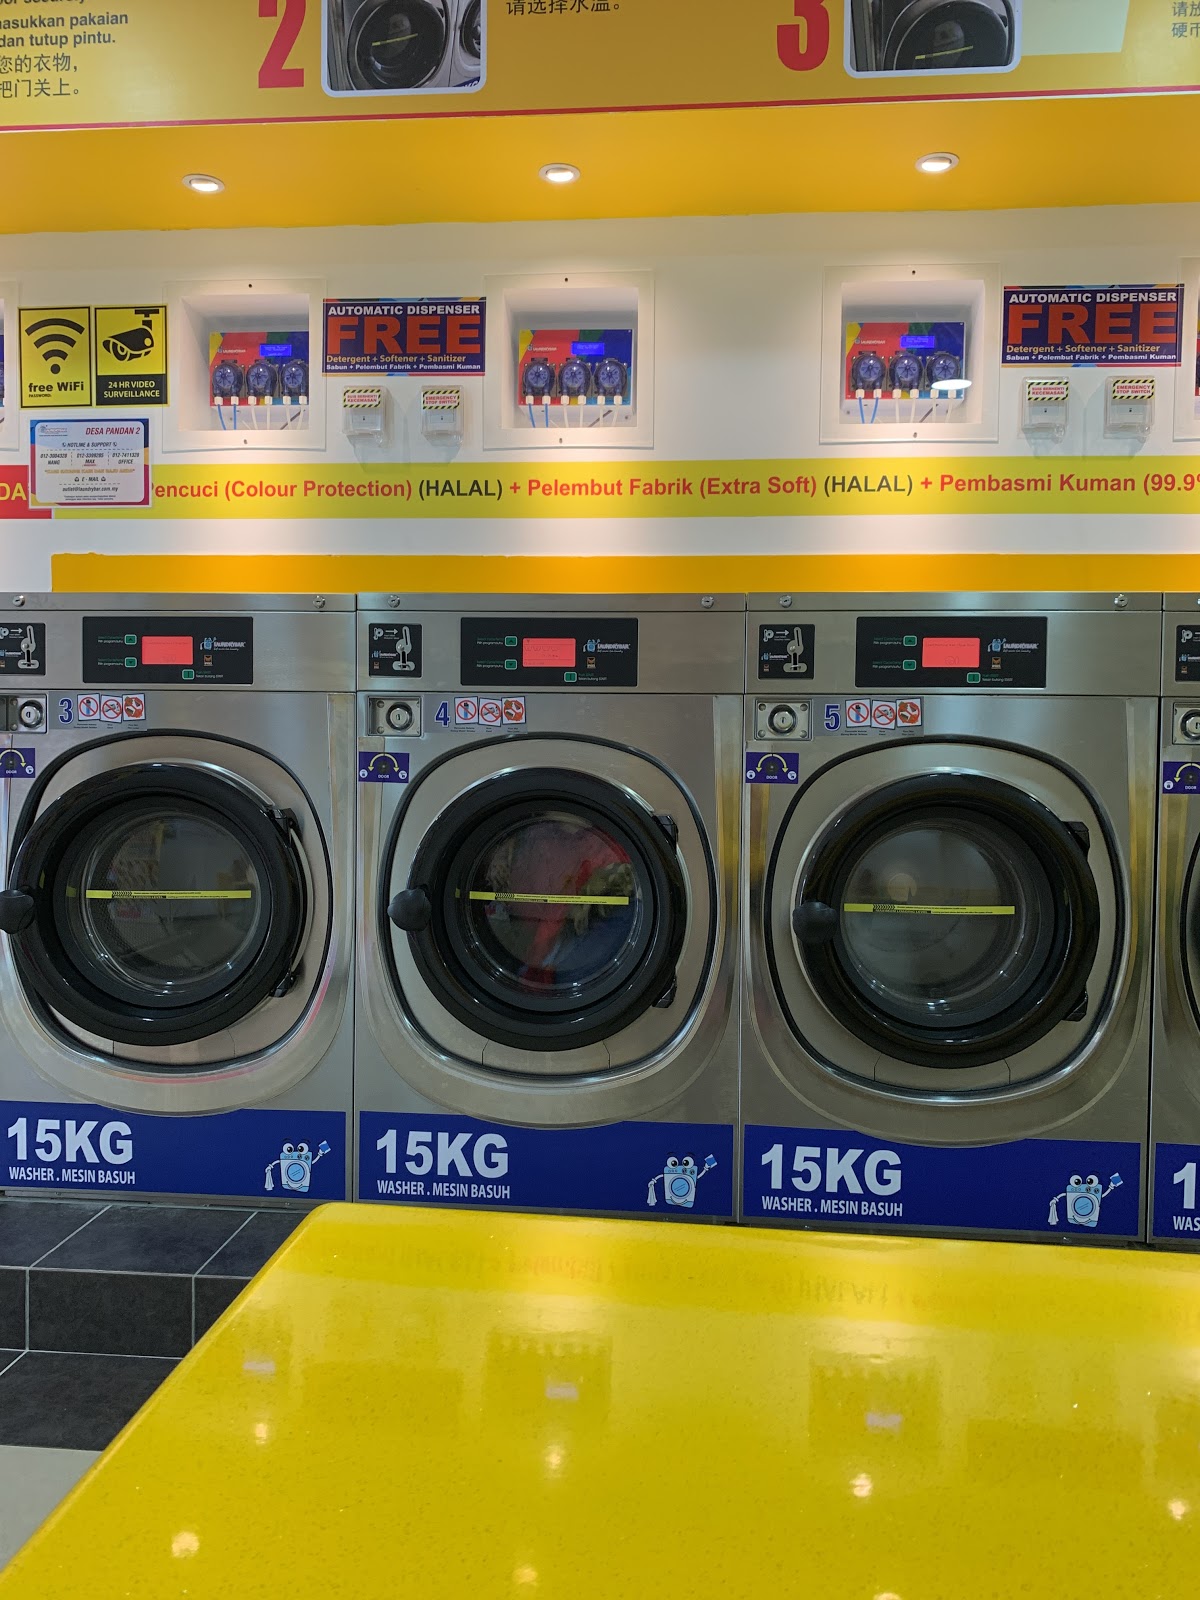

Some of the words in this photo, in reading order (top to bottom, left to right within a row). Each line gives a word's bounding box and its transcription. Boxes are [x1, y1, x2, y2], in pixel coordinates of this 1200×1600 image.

[0, 15, 64, 29] asukkan
[70, 12, 129, 30] pakaian
[29, 33, 68, 48] tutup
[73, 31, 116, 48] pintu.
[258, 0, 306, 88] 2
[1008, 293, 1092, 304] AUTOMATIC
[1096, 292, 1177, 303] DISPENSER
[328, 305, 404, 316] AUTOMATIC
[407, 304, 480, 315] DISPENSER
[1007, 303, 1177, 344] FREE
[326, 315, 481, 355] FREE
[326, 355, 371, 364] Detergent
[380, 355, 418, 363] Softener
[427, 354, 466, 363] Sanitizer
[1006, 345, 1054, 354] Detergent
[1065, 344, 1107, 353] Softener
[1117, 344, 1160, 352] Sanitizer
[28, 383, 54, 392] free
[57, 381, 84, 391] WiFi
[103, 389, 160, 398] SURVEILLANCE
[108, 381, 119, 389] 24
[120, 381, 129, 389] HR
[130, 380, 155, 388] VIDEO
[85, 427, 103, 435] DESA
[106, 427, 135, 435] PANDAN
[135, 427, 141, 435] 2
[152, 479, 219, 498] encuci
[224, 479, 299, 502] (Colour
[302, 478, 412, 502] Protection)
[418, 478, 504, 501] (HALAL)
[509, 481, 521, 494] +
[527, 478, 623, 497] Pelembut
[629, 477, 693, 496] Fabrik
[699, 476, 761, 500] (Extra
[767, 475, 818, 499] Soft)
[824, 474, 913, 498] (HALAL)
[920, 477, 933, 490] +
[939, 473, 1052, 492] Pembasmi
[1059, 473, 1136, 492] Kuman
[1143, 473, 1200, 496] (99.9
[59, 698, 73, 724] 3
[434, 701, 450, 728] 4
[824, 703, 841, 731] 5
[7, 1117, 133, 1164] 15KG
[376, 1129, 509, 1178] 15KG
[9, 1166, 55, 1181] WASHER
[61, 1168, 96, 1183] MESIN
[98, 1170, 136, 1185] BASUH
[761, 1143, 902, 1196] 15KG
[377, 1179, 425, 1196] WASHER
[433, 1182, 469, 1198] MESIN
[471, 1184, 511, 1199] BASUH
[761, 1196, 812, 1213] WASHER
[820, 1198, 859, 1215] MESIN
[861, 1200, 903, 1217] BASUH
